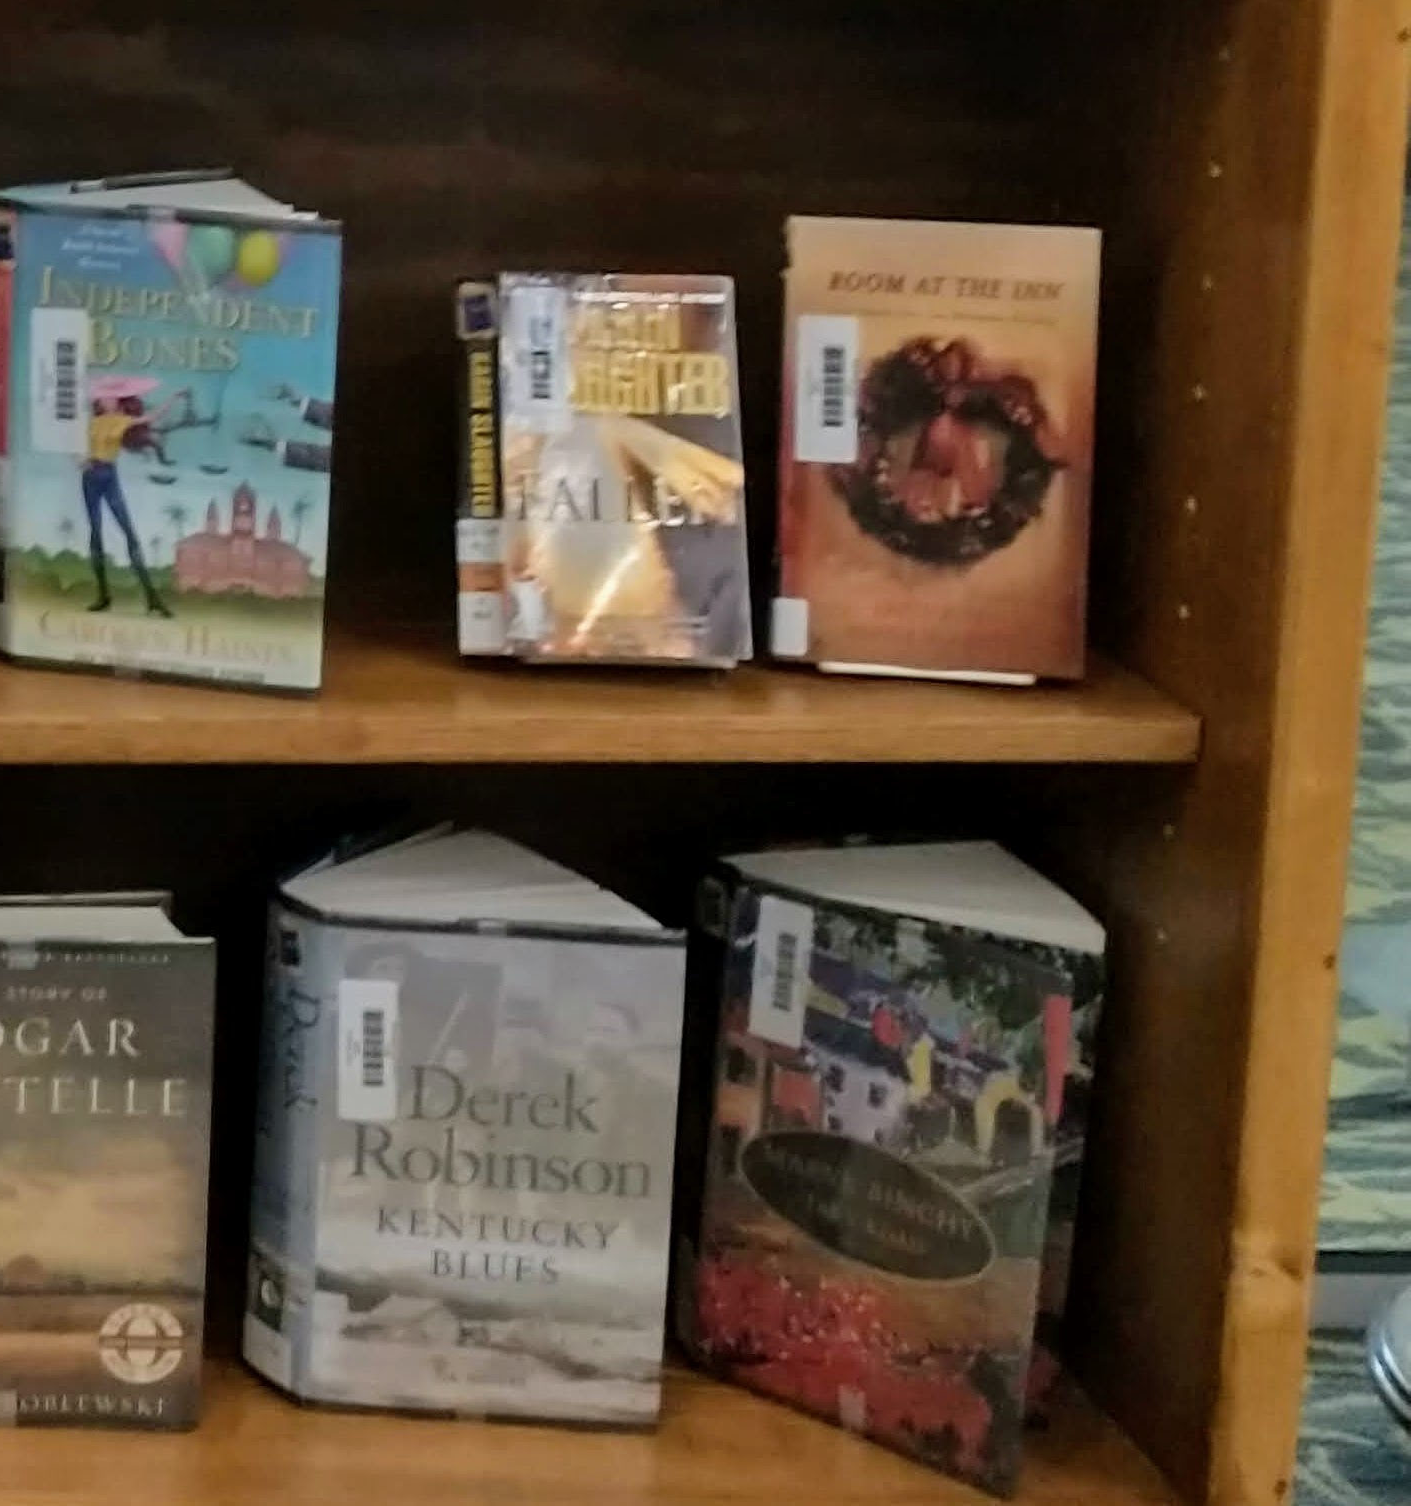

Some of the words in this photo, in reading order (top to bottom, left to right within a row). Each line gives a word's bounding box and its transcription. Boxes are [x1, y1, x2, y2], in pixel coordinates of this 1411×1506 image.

[38, 266, 322, 340] INDEPENDENT
[826, 270, 908, 295] ROOM
[913, 276, 945, 297] AT
[953, 278, 1004, 300] THE
[1012, 281, 1066, 301] INN
[87, 321, 242, 370] BONES
[81, 987, 109, 1001] OF
[410, 1064, 600, 1135] Derek
[349, 1122, 652, 1200] Robinson
[377, 1206, 621, 1249] KENTUCKY
[430, 1247, 560, 1286] BLUES
